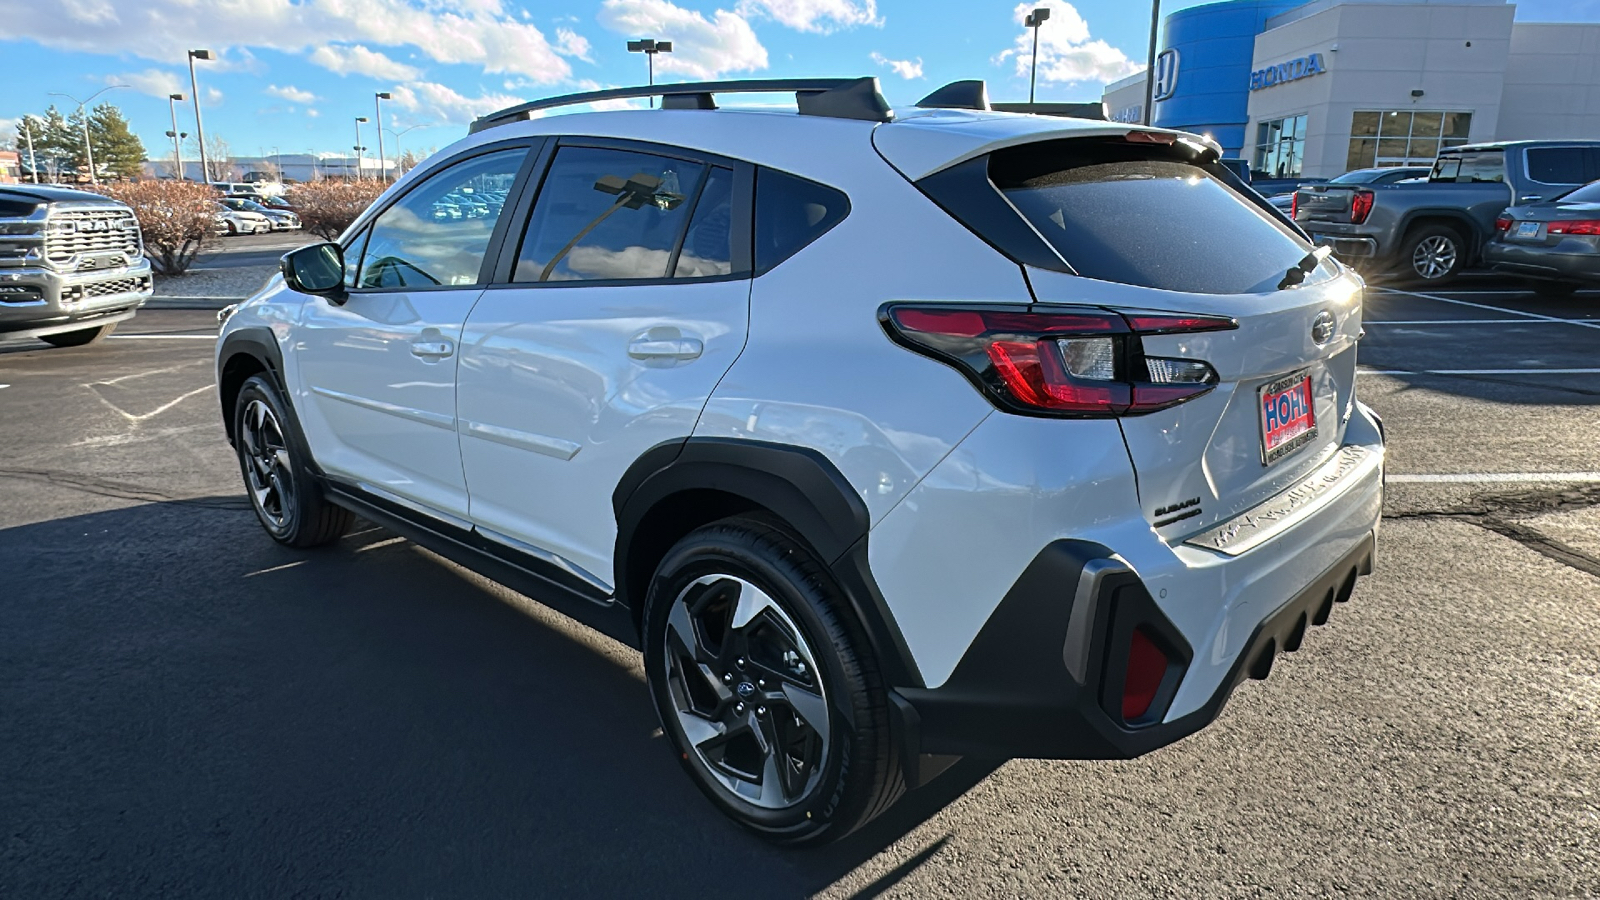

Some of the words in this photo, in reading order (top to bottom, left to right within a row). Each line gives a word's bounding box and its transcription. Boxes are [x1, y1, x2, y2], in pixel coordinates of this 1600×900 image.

[1249, 53, 1326, 91] HONDA
[77, 219, 123, 231] RAM
[1264, 386, 1309, 432] HOHL
[1154, 496, 1201, 517] SUBARU
